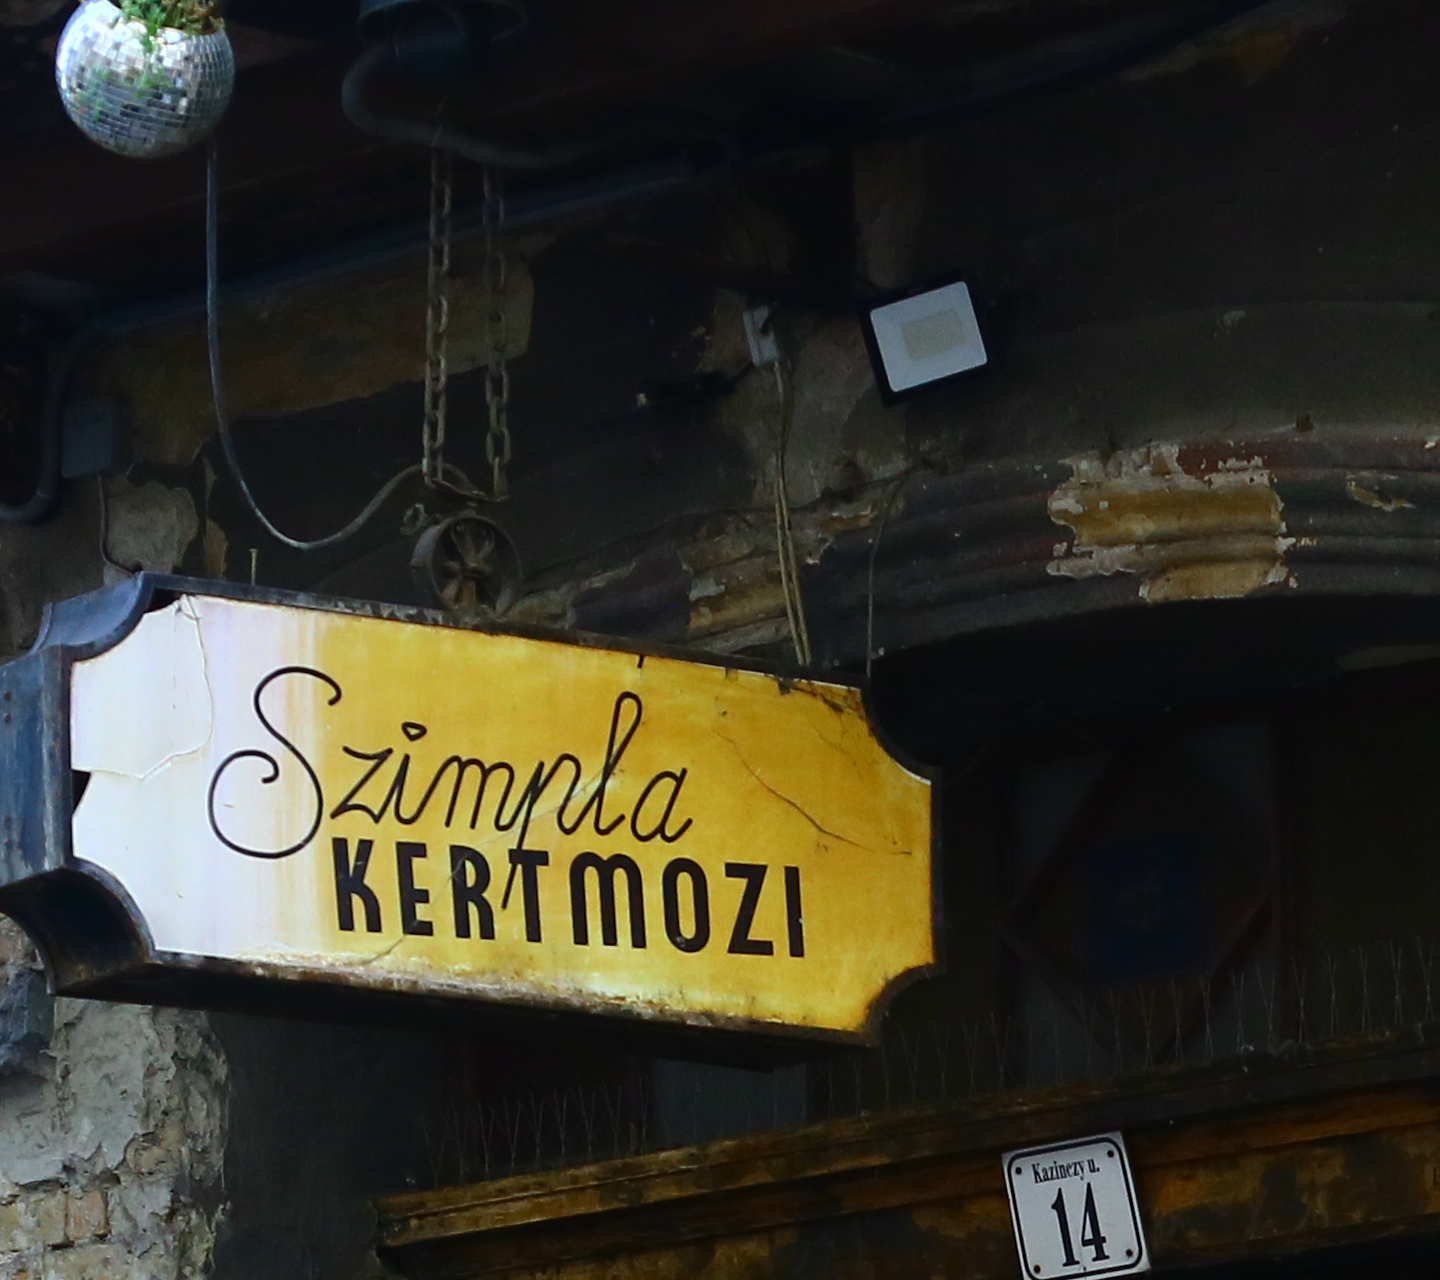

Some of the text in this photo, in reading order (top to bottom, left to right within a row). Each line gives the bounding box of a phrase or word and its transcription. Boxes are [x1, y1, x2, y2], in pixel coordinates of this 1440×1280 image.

[207, 665, 692, 911] Szimpla
[331, 835, 806, 957] KERTMOZI
[1031, 1157, 1100, 1186] Kazinczy u.
[1050, 1181, 1109, 1267] 14
